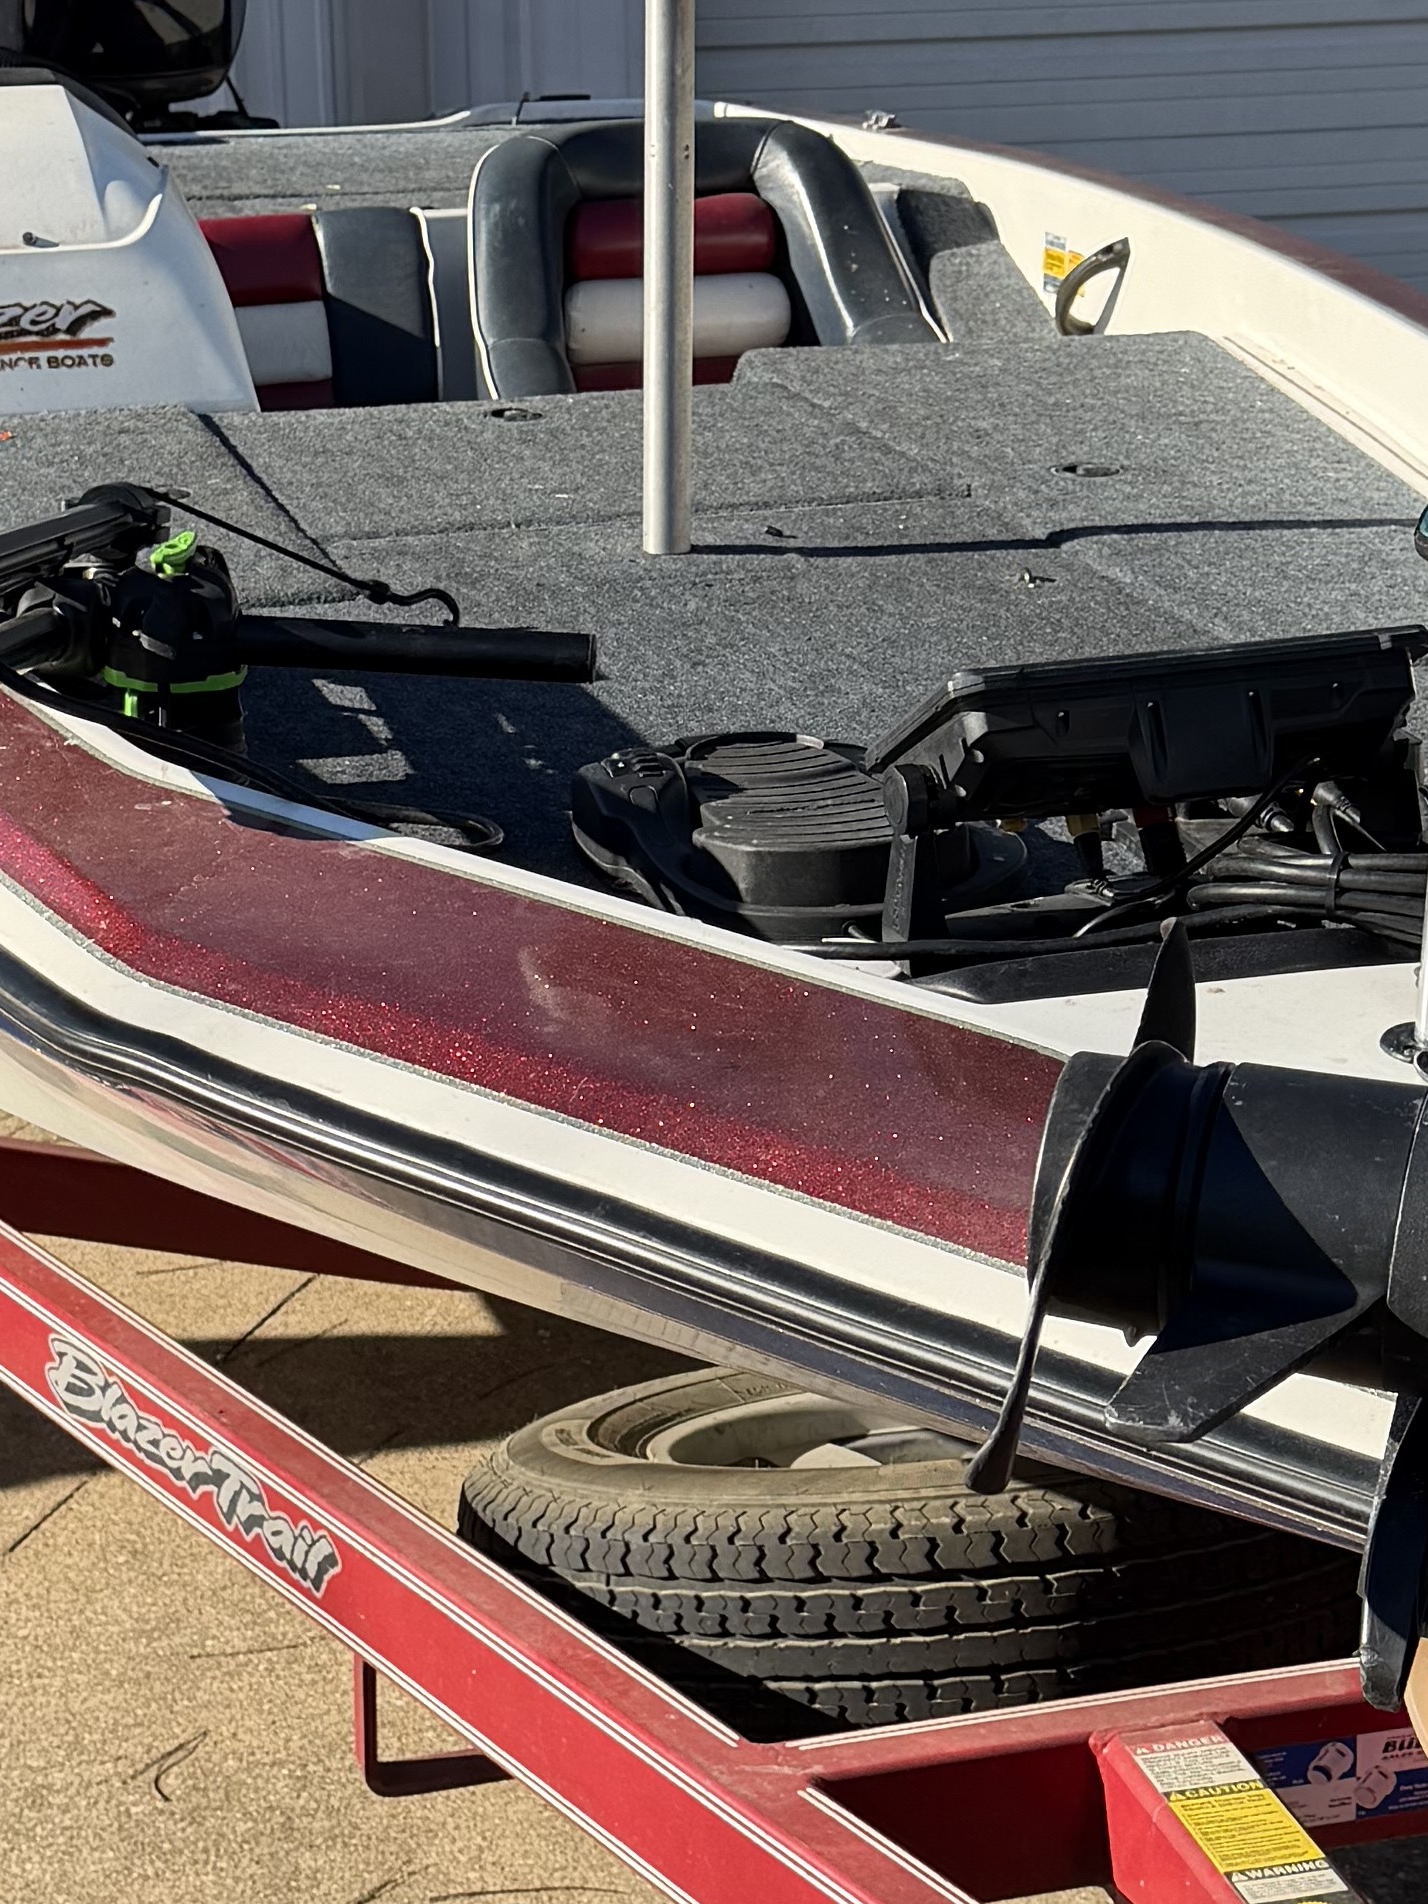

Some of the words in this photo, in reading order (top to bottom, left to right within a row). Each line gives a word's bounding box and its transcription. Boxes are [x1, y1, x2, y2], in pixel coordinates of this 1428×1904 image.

[46, 352, 115, 370] BOATS
[1151, 1735, 1225, 1752] DANGER
[1183, 1778, 1264, 1798] CAUTION
[1244, 1859, 1330, 1880] WARNING
